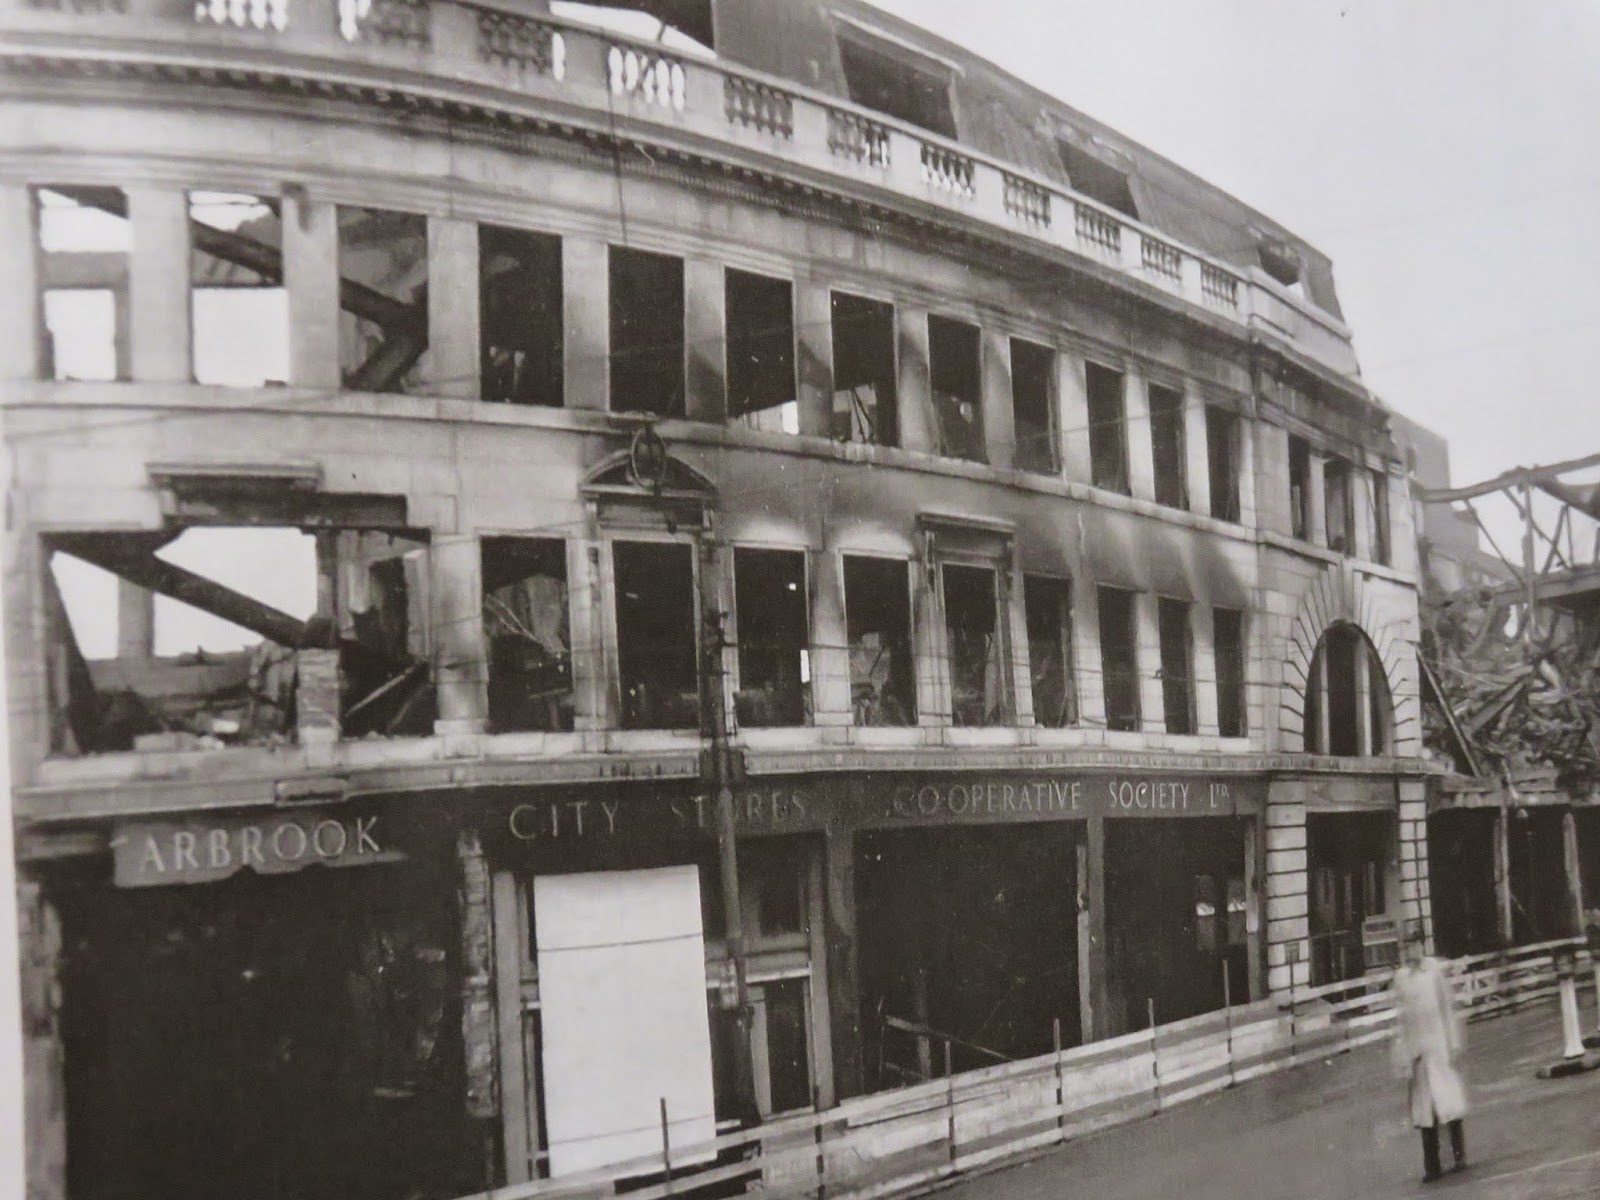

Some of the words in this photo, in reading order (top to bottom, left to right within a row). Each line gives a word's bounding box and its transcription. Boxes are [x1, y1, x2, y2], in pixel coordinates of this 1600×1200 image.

[110, 816, 379, 873] ARBROOK
[509, 801, 618, 839] CITY
[670, 790, 809, 829] STRES
[1108, 781, 1190, 809] SOCIETY
